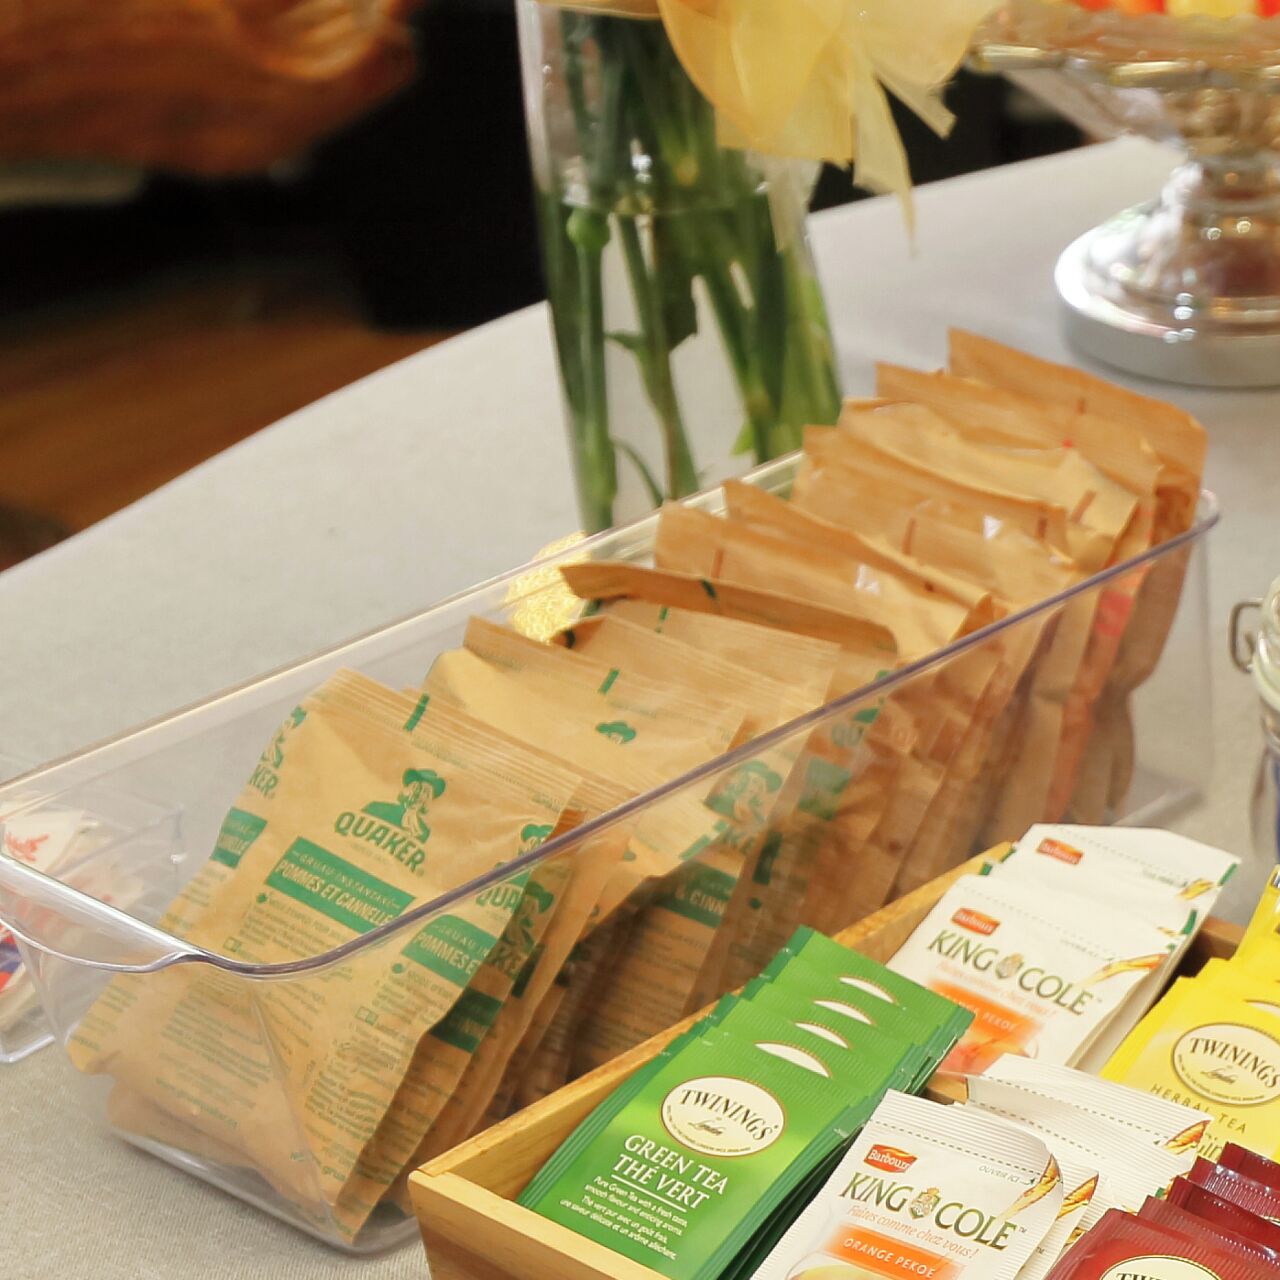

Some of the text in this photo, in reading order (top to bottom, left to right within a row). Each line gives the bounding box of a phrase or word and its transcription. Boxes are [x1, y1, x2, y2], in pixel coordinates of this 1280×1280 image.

[334, 811, 426, 873] QUAKER
[275, 860, 321, 893] POMMES
[322, 882, 338, 900] ET
[412, 933, 470, 969] POMMES
[926, 929, 1000, 968] KING
[1018, 966, 1095, 1017] COLE
[679, 1088, 772, 1140] TWININGS
[1150, 1083, 1247, 1134] HERBAL TEA
[612, 1154, 710, 1209] THÉ VERT
[624, 1134, 729, 1195] GREEN TEA
[839, 1172, 1017, 1250] KING COLE
[848, 1205, 878, 1223] Faites
[877, 1214, 918, 1236] comme
[917, 1228, 944, 1247] chez
[843, 1238, 936, 1279] ORANGE PEKOE
